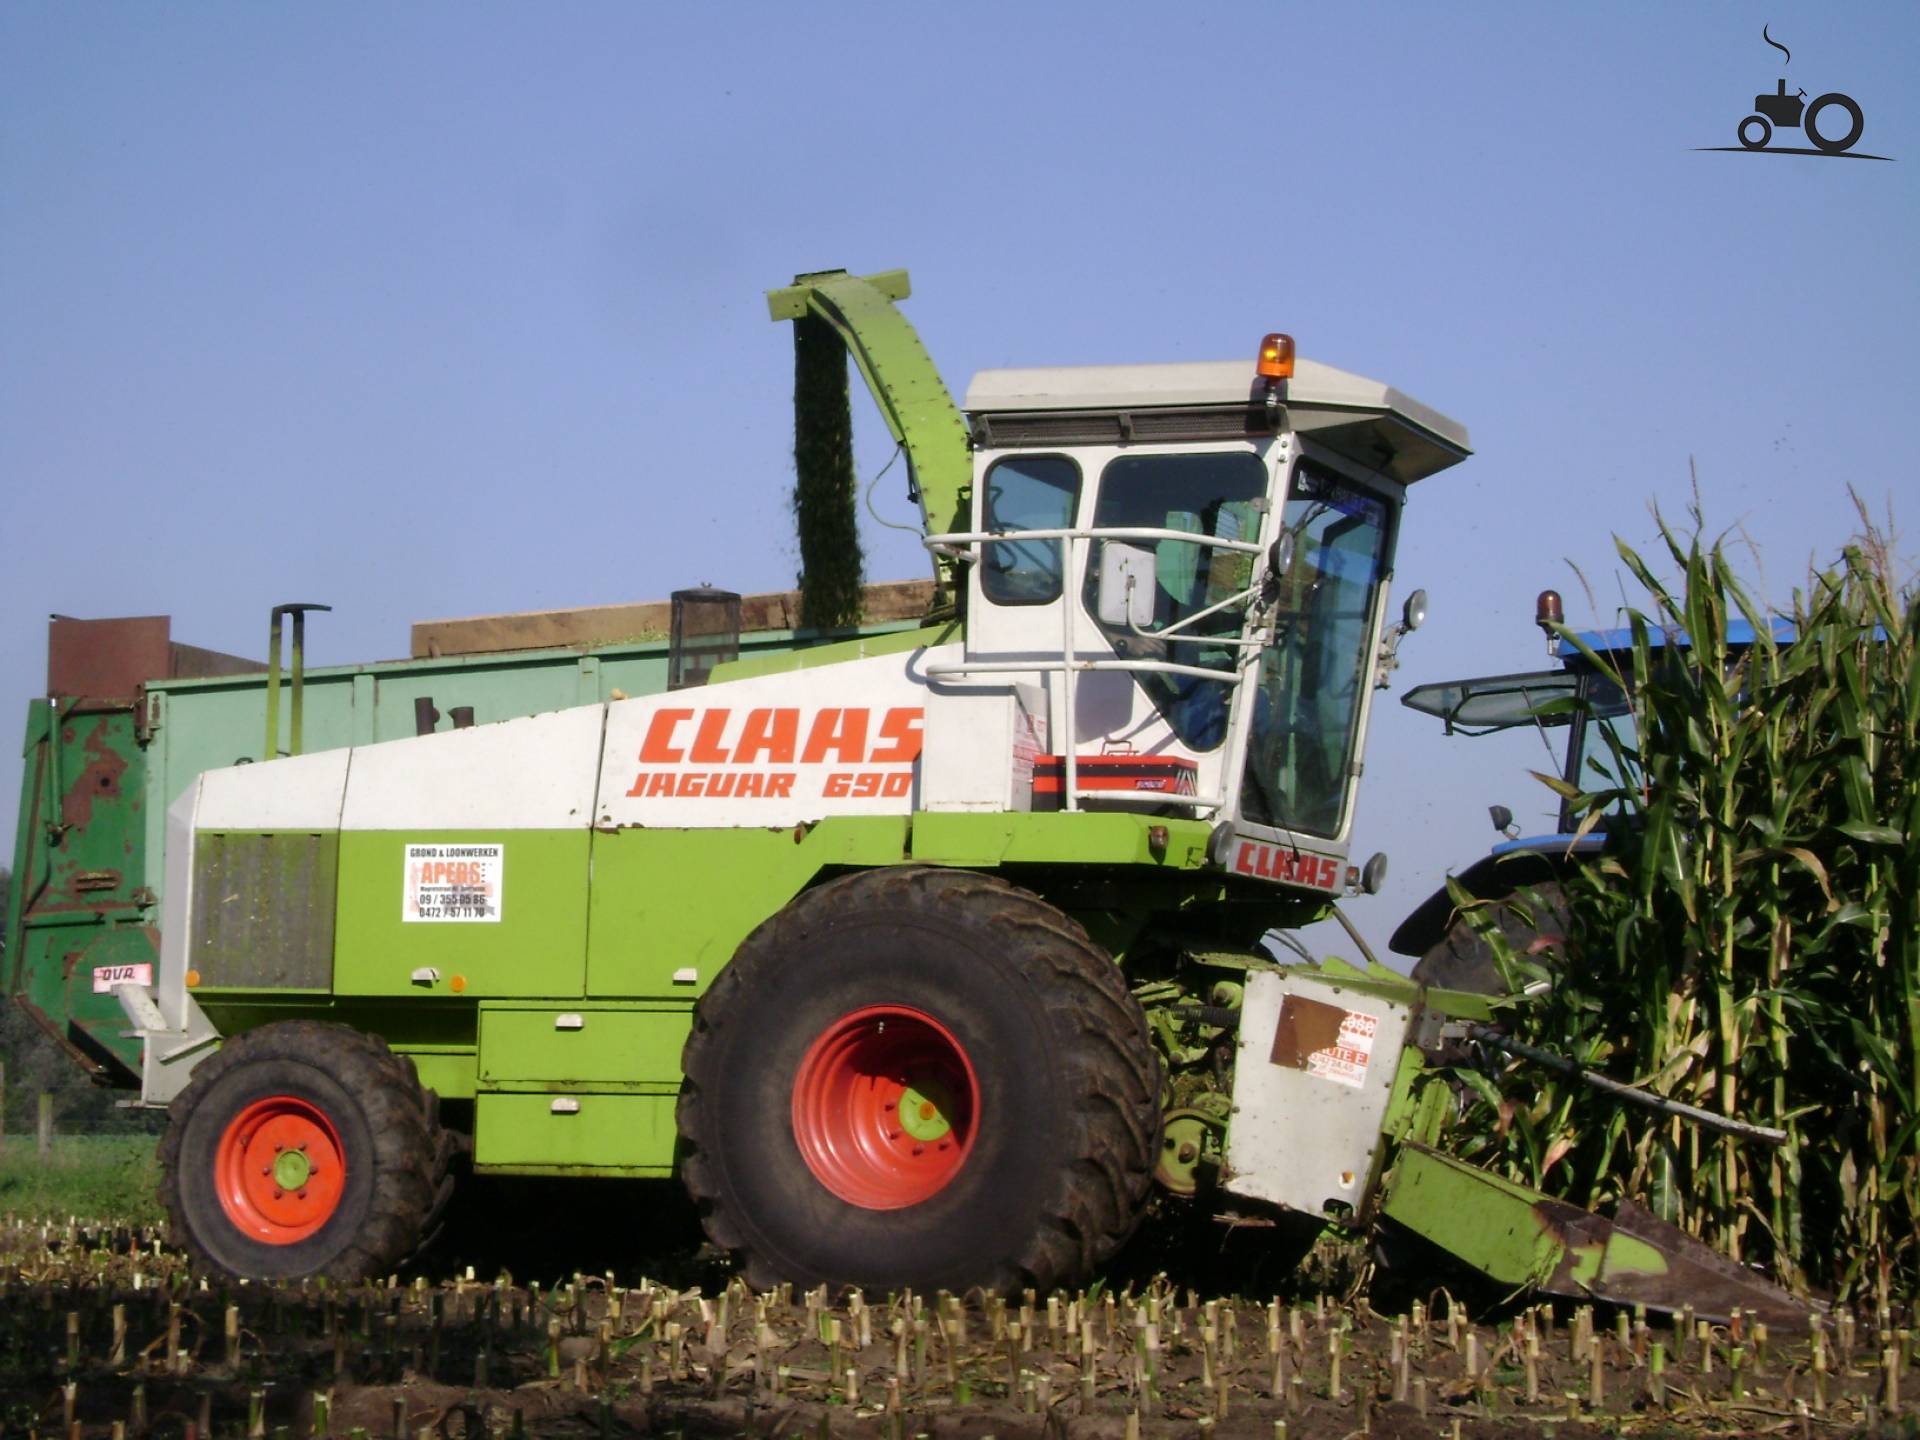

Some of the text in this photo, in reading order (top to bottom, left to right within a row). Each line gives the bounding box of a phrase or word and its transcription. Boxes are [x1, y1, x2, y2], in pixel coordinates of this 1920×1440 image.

[639, 708, 924, 763] CLAAS
[626, 773, 912, 797] JAGUAR 690
[410, 848, 437, 857] GROND
[446, 848, 498, 857] LOONWERKEN
[421, 862, 480, 884] APERS
[1236, 842, 1338, 889] CLAAS
